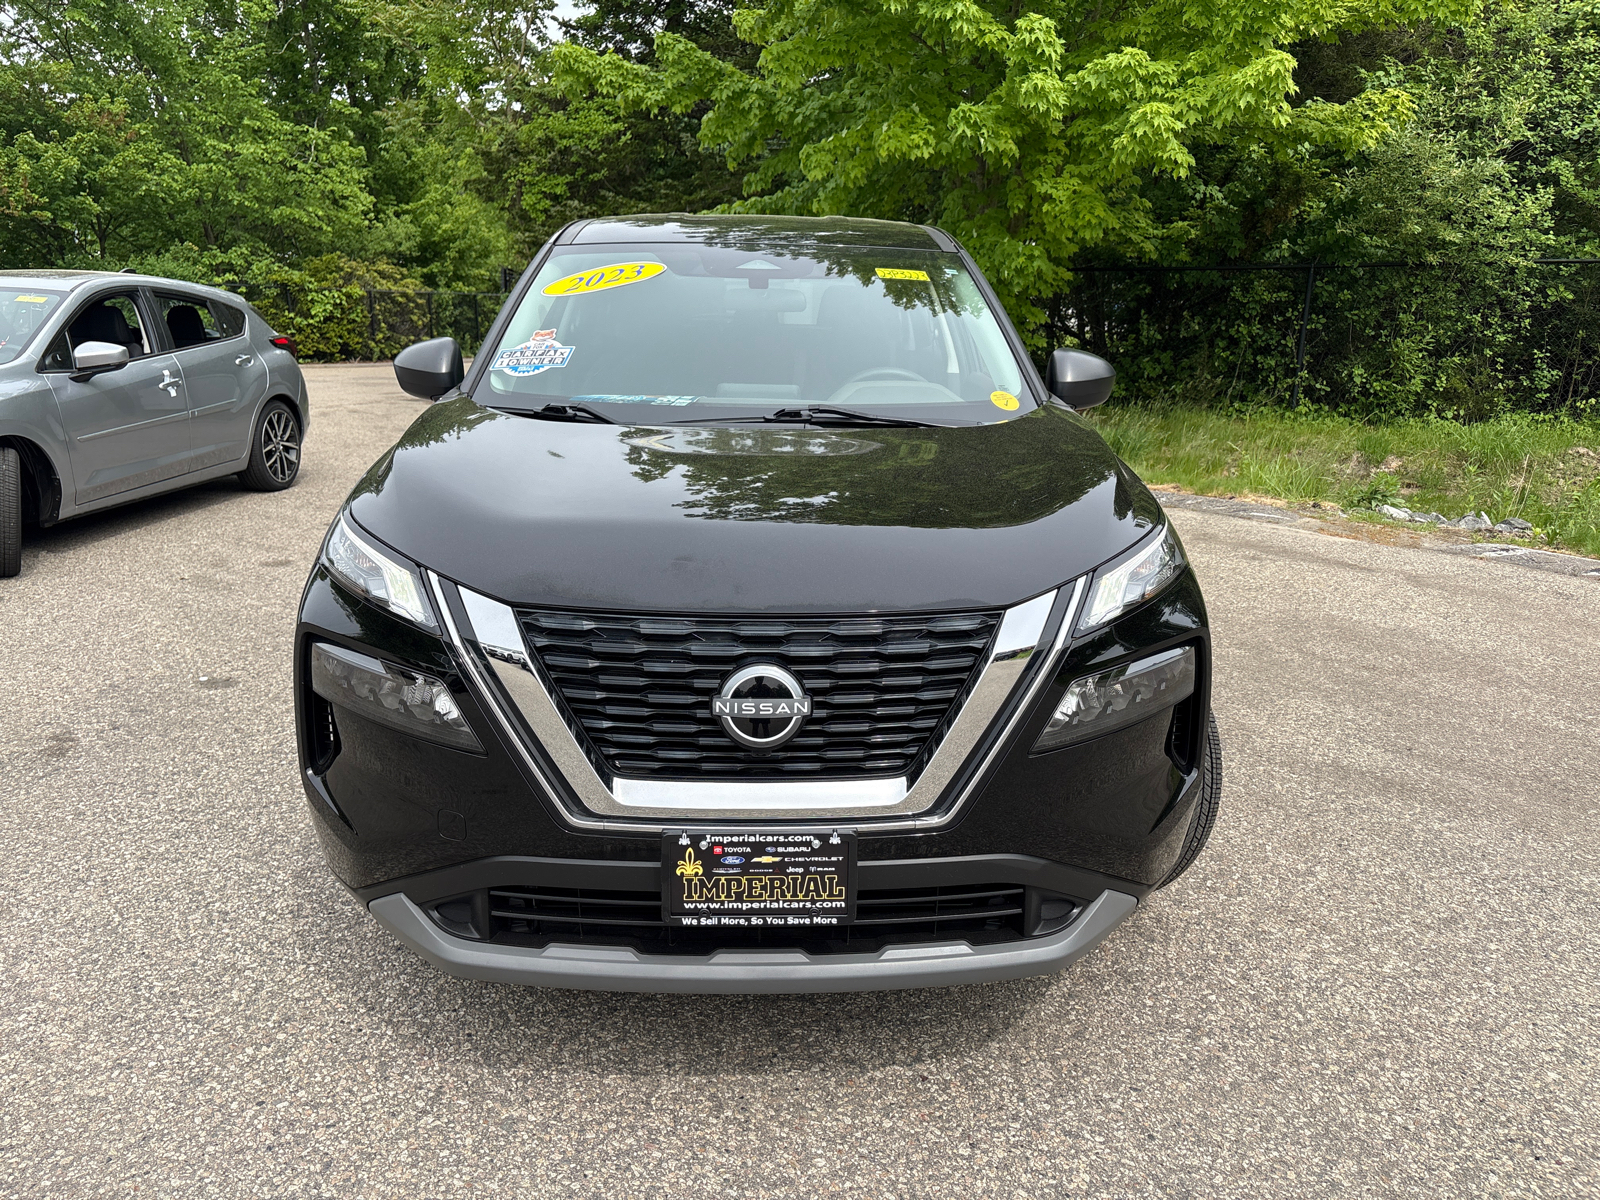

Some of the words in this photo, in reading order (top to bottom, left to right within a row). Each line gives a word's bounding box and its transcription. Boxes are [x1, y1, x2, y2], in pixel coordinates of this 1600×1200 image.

[563, 265, 645, 293] 2023
[500, 349, 568, 359] CARFAX
[507, 357, 565, 367] OWNER
[715, 701, 808, 715] NISSAN
[705, 834, 815, 844] Imperialcars.com
[683, 875, 846, 901] IMPERIAL
[684, 900, 846, 910] www.imperialcars.com
[682, 917, 698, 926] We
[700, 917, 718, 925] Sell
[720, 917, 749, 926] More,
[750, 917, 764, 925] So
[766, 917, 785, 925] You
[787, 917, 811, 925] Save
[813, 917, 838, 925] More
